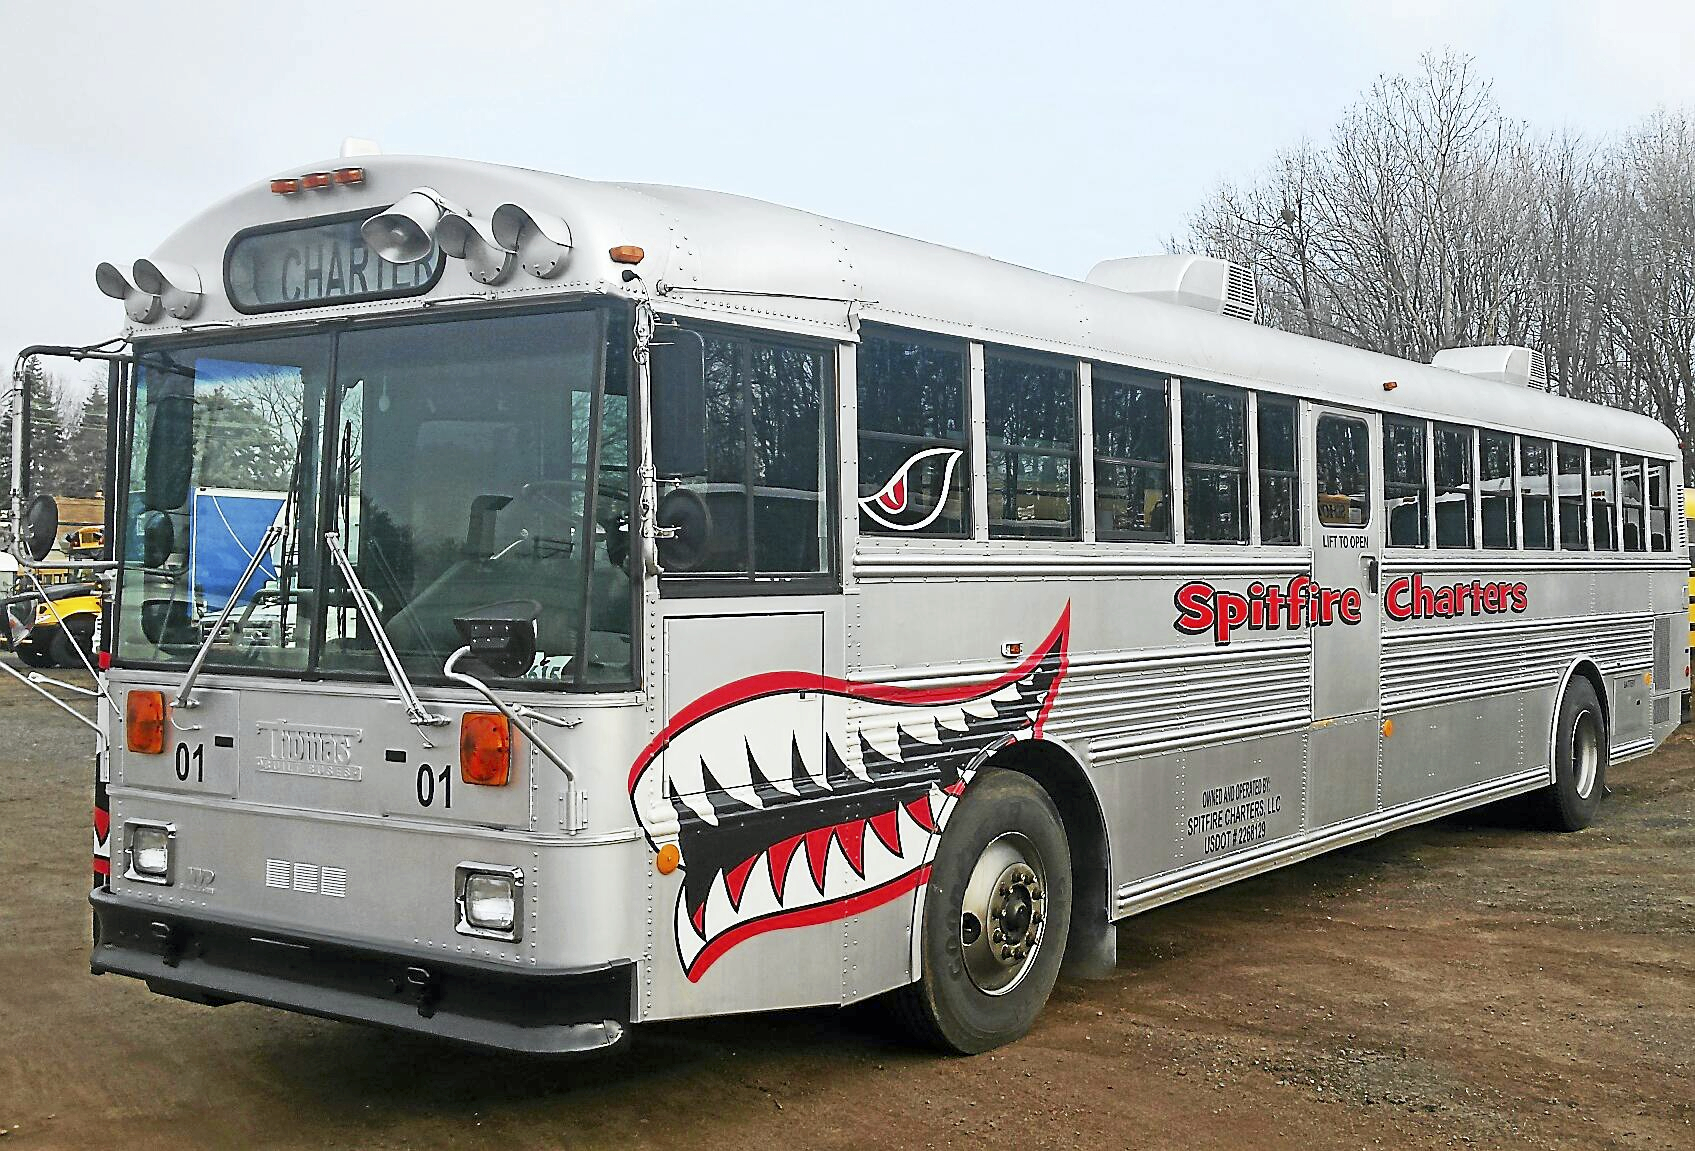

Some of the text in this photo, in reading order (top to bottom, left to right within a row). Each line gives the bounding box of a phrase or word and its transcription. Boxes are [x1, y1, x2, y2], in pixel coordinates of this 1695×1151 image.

[1322, 535, 1369, 548] LIFT TO OPEN
[1173, 572, 1528, 646] Spitfire Charters
[175, 742, 204, 782] 01
[257, 720, 361, 764] Thomas
[417, 764, 452, 809] 01
[1202, 788, 1222, 808] OWNED
[1223, 785, 1235, 803] AND
[1235, 779, 1262, 800] OPERATED
[1187, 795, 1281, 836] SPITFIRE CHARTERS, LLC
[1204, 821, 1266, 854] USDOT # 2268129
